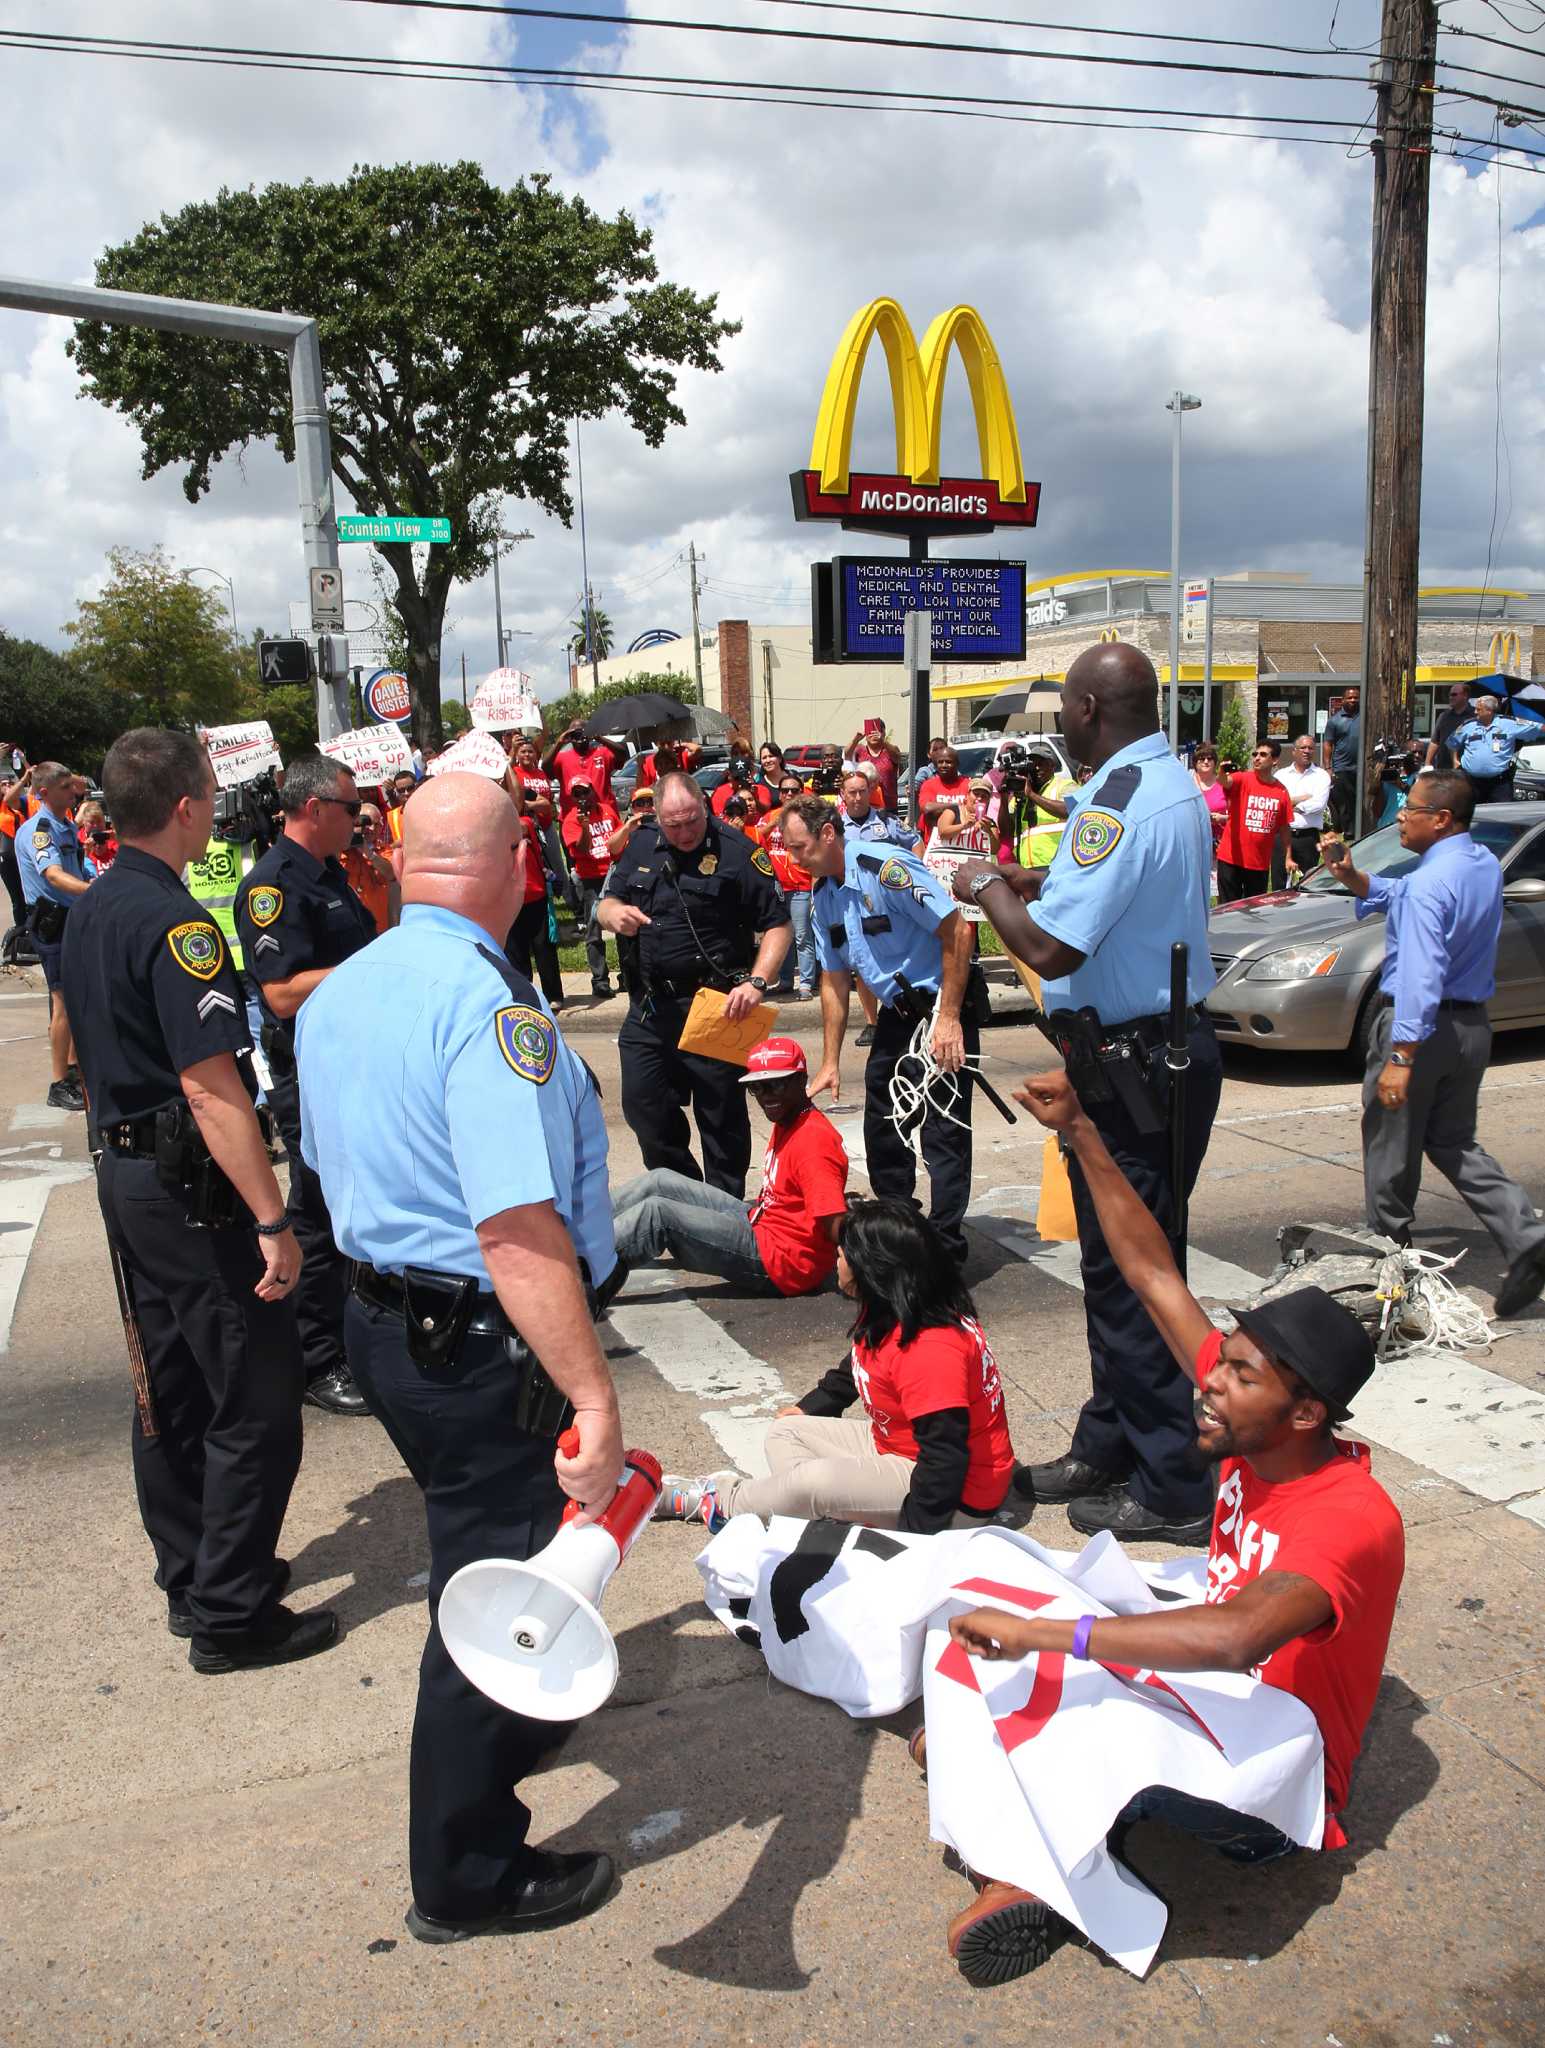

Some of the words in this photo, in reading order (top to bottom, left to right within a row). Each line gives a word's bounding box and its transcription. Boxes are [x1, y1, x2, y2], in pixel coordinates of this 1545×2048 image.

[860, 490, 988, 515] McDonald's
[341, 519, 391, 537] Fountain
[393, 521, 421, 537] View
[432, 519, 443, 528] DR
[431, 530, 449, 538] 3100
[856, 566, 935, 577] MCDONALD'S
[942, 568, 1000, 579] PROVIDES
[858, 581, 911, 592] MEDICAL
[919, 581, 944, 592] AND
[952, 582, 1000, 593] DENTAL
[858, 595, 891, 606] CARE
[899, 596, 916, 606] TO
[924, 596, 949, 607] LOW
[956, 597, 1000, 608] INCOME
[868, 609, 920, 621] FAMIL
[932, 611, 961, 622] WITH
[969, 611, 992, 622] OUR
[859, 624, 905, 635] DENTA
[951, 625, 1000, 636] MEDICAL
[374, 681, 404, 702] DAVE
[208, 731, 259, 752] FAMILIES
[1247, 795, 1280, 811] FIGHT
[1245, 809, 1264, 821] FOR
[588, 820, 614, 836] IGHT
[211, 857, 230, 873] 13
[926, 855, 958, 870] Bette
[195, 878, 237, 887] HOUSTON
[506, 1011, 552, 1032] HOUSTON
